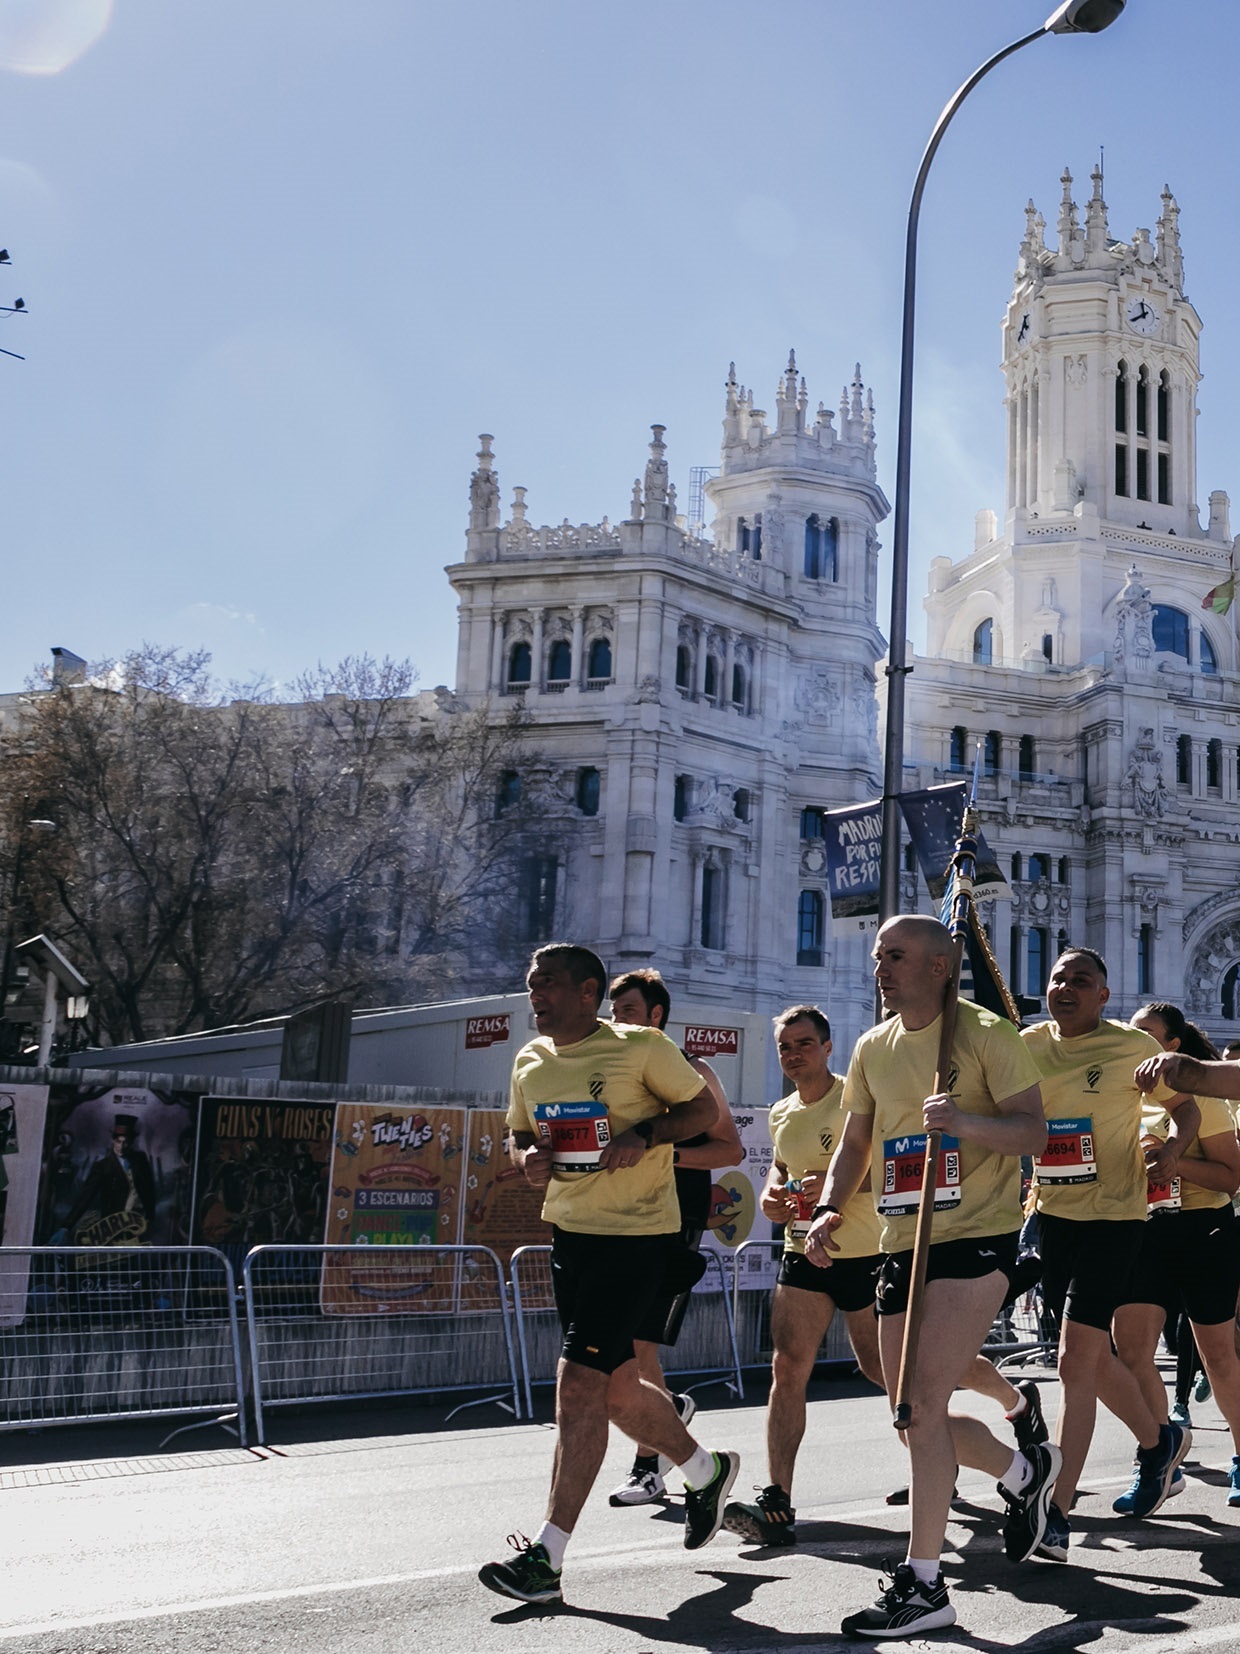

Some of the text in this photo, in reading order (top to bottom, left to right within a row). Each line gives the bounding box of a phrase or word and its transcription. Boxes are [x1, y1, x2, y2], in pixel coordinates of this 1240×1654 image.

[846, 841, 882, 864] POR FI
[835, 860, 882, 890] RESPI
[973, 888, 999, 899] d360.es
[467, 1016, 510, 1034] REMSA
[686, 1028, 736, 1045] REMSA
[216, 1104, 262, 1138] GUNS
[282, 1107, 332, 1140] ROSES
[734, 1115, 754, 1128] age
[749, 1147, 759, 1156] EL
[899, 1163, 922, 1178] 166
[358, 1191, 434, 1205] 3 ESCENARIOS
